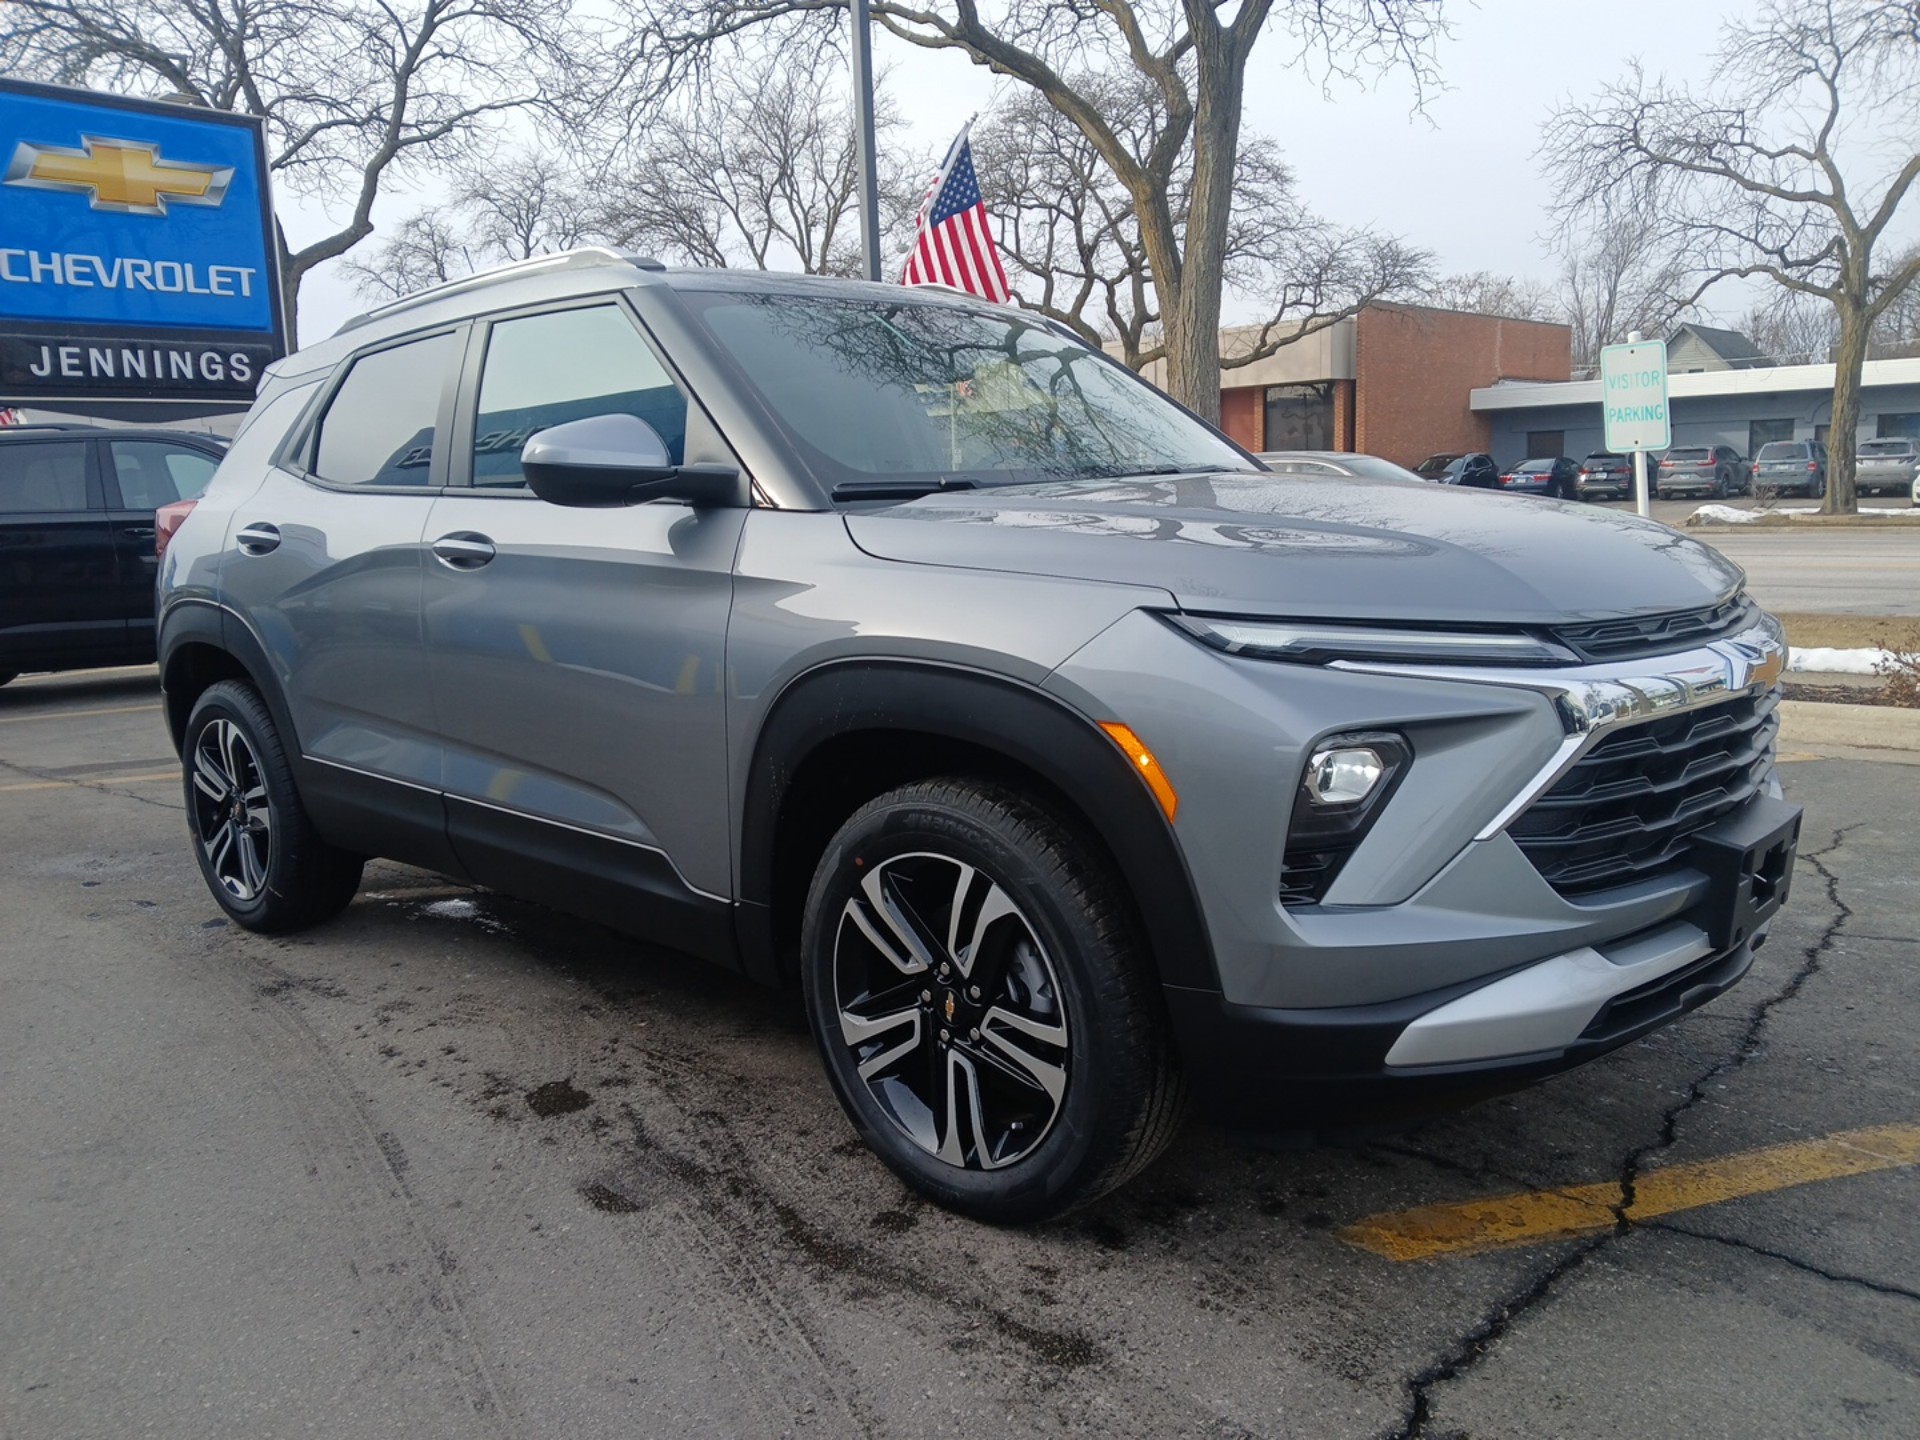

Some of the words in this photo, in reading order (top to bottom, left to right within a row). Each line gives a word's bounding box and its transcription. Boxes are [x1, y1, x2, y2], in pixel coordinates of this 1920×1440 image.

[0, 248, 256, 297] CHEVROLET
[29, 346, 251, 382] JENNINGS
[1608, 370, 1660, 389] VISITOR
[1608, 404, 1664, 422] PARKING
